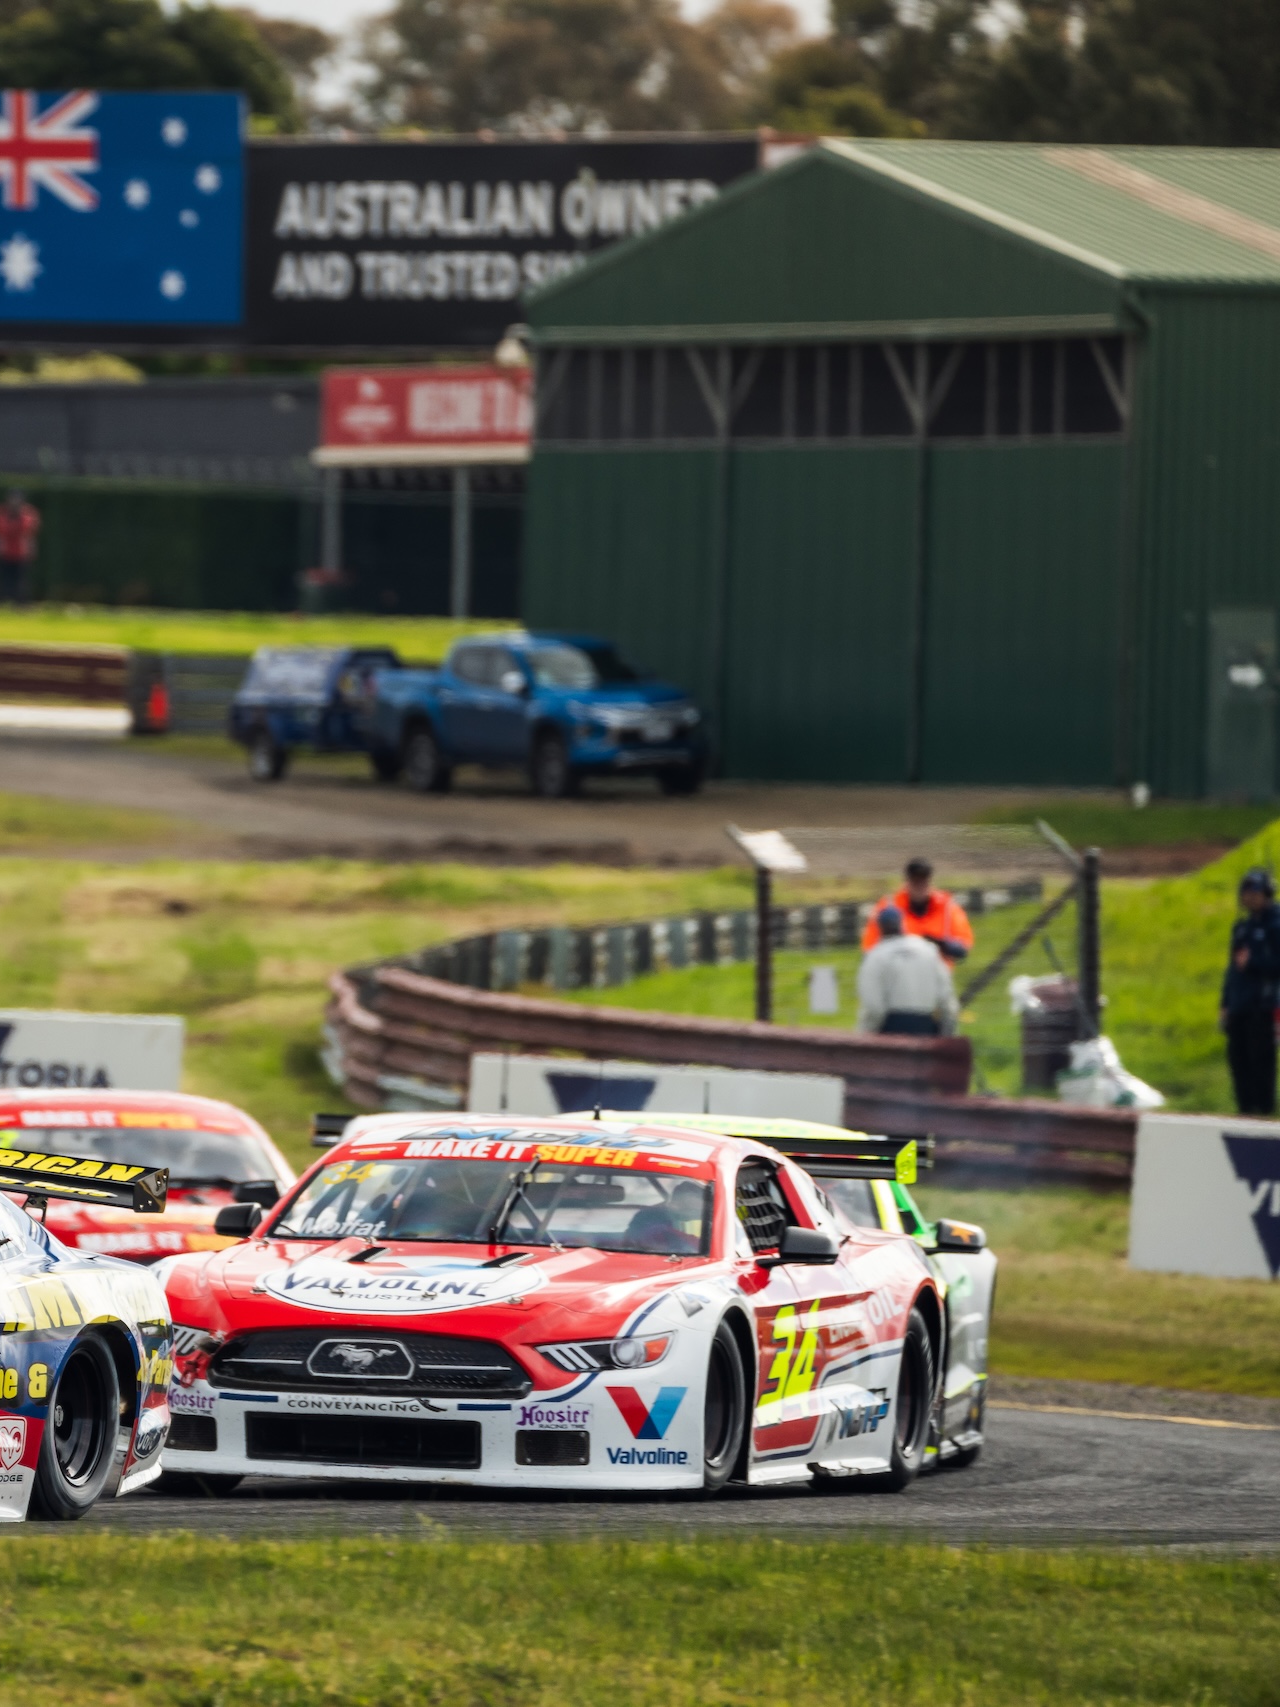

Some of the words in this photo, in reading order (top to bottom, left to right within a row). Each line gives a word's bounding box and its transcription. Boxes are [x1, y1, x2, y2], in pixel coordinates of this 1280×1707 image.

[273, 181, 555, 238] AUSTRALIAN
[273, 251, 354, 298] AND
[356, 251, 520, 299] TRUSTED
[403, 1140, 495, 1159] MAKE
[499, 1142, 533, 1160] IT
[532, 1144, 638, 1167] SUPER
[322, 1162, 376, 1185] 34
[299, 1216, 386, 1237] Moffat
[284, 1272, 495, 1298] VALVOLINE
[756, 1297, 821, 1428] 34
[27, 1362, 48, 1399] &
[287, 1399, 420, 1412] CONVEYANCING
[515, 1404, 590, 1426] Hoosier
[606, 1447, 688, 1465] Valvoline
